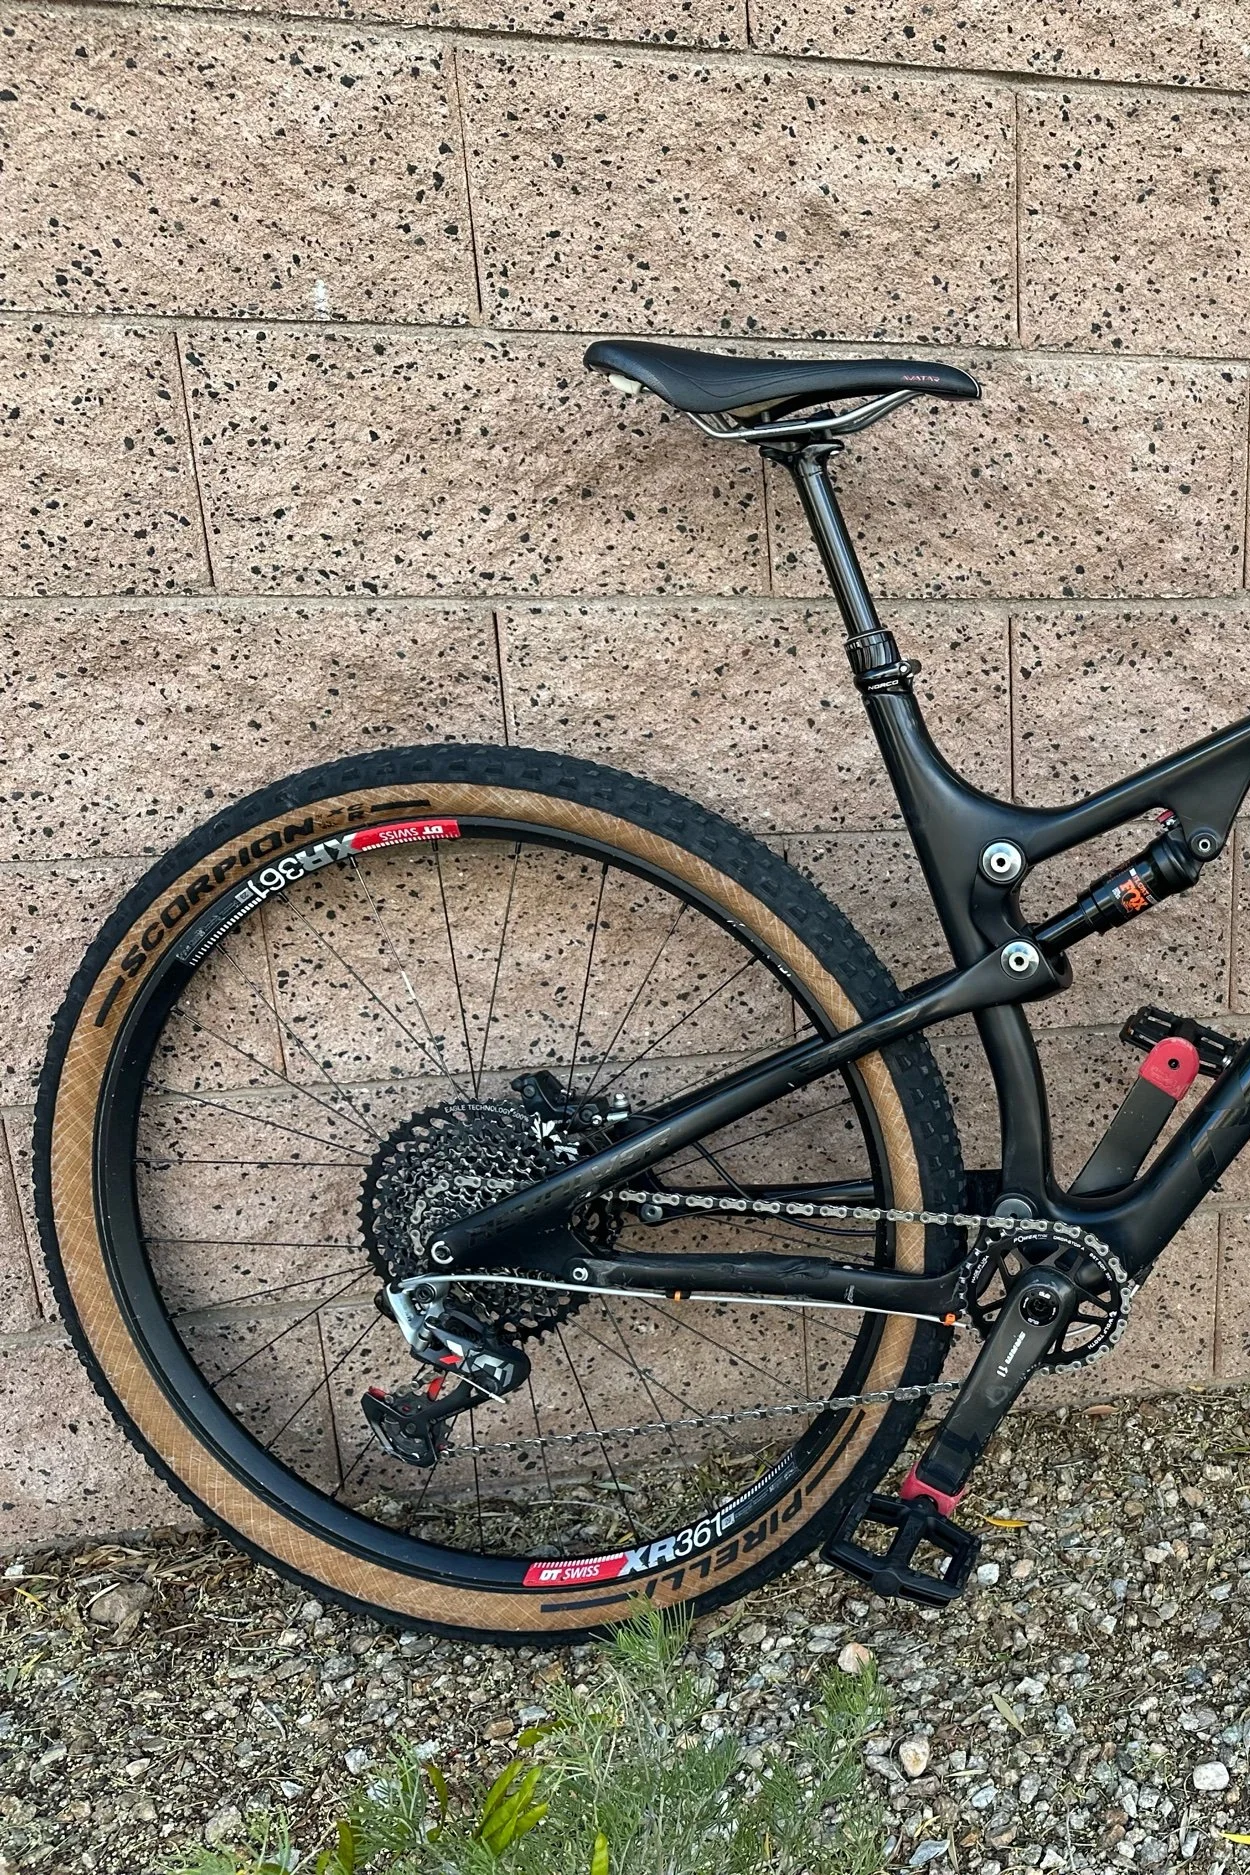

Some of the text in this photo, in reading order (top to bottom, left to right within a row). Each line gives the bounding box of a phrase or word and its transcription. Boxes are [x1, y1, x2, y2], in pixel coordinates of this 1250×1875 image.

[867, 680, 899, 691] NORCO
[247, 825, 443, 899] DT SWISS XR361
[121, 817, 314, 978] SCORPION
[1119, 879, 1149, 912] FOX
[444, 1103, 530, 1123] EAGLE TECHNOLOGY 500%
[1004, 1331, 1026, 1365] SRAM
[539, 1512, 722, 1581] DT SWISS XR361
[645, 1488, 803, 1600] PIRELLI
